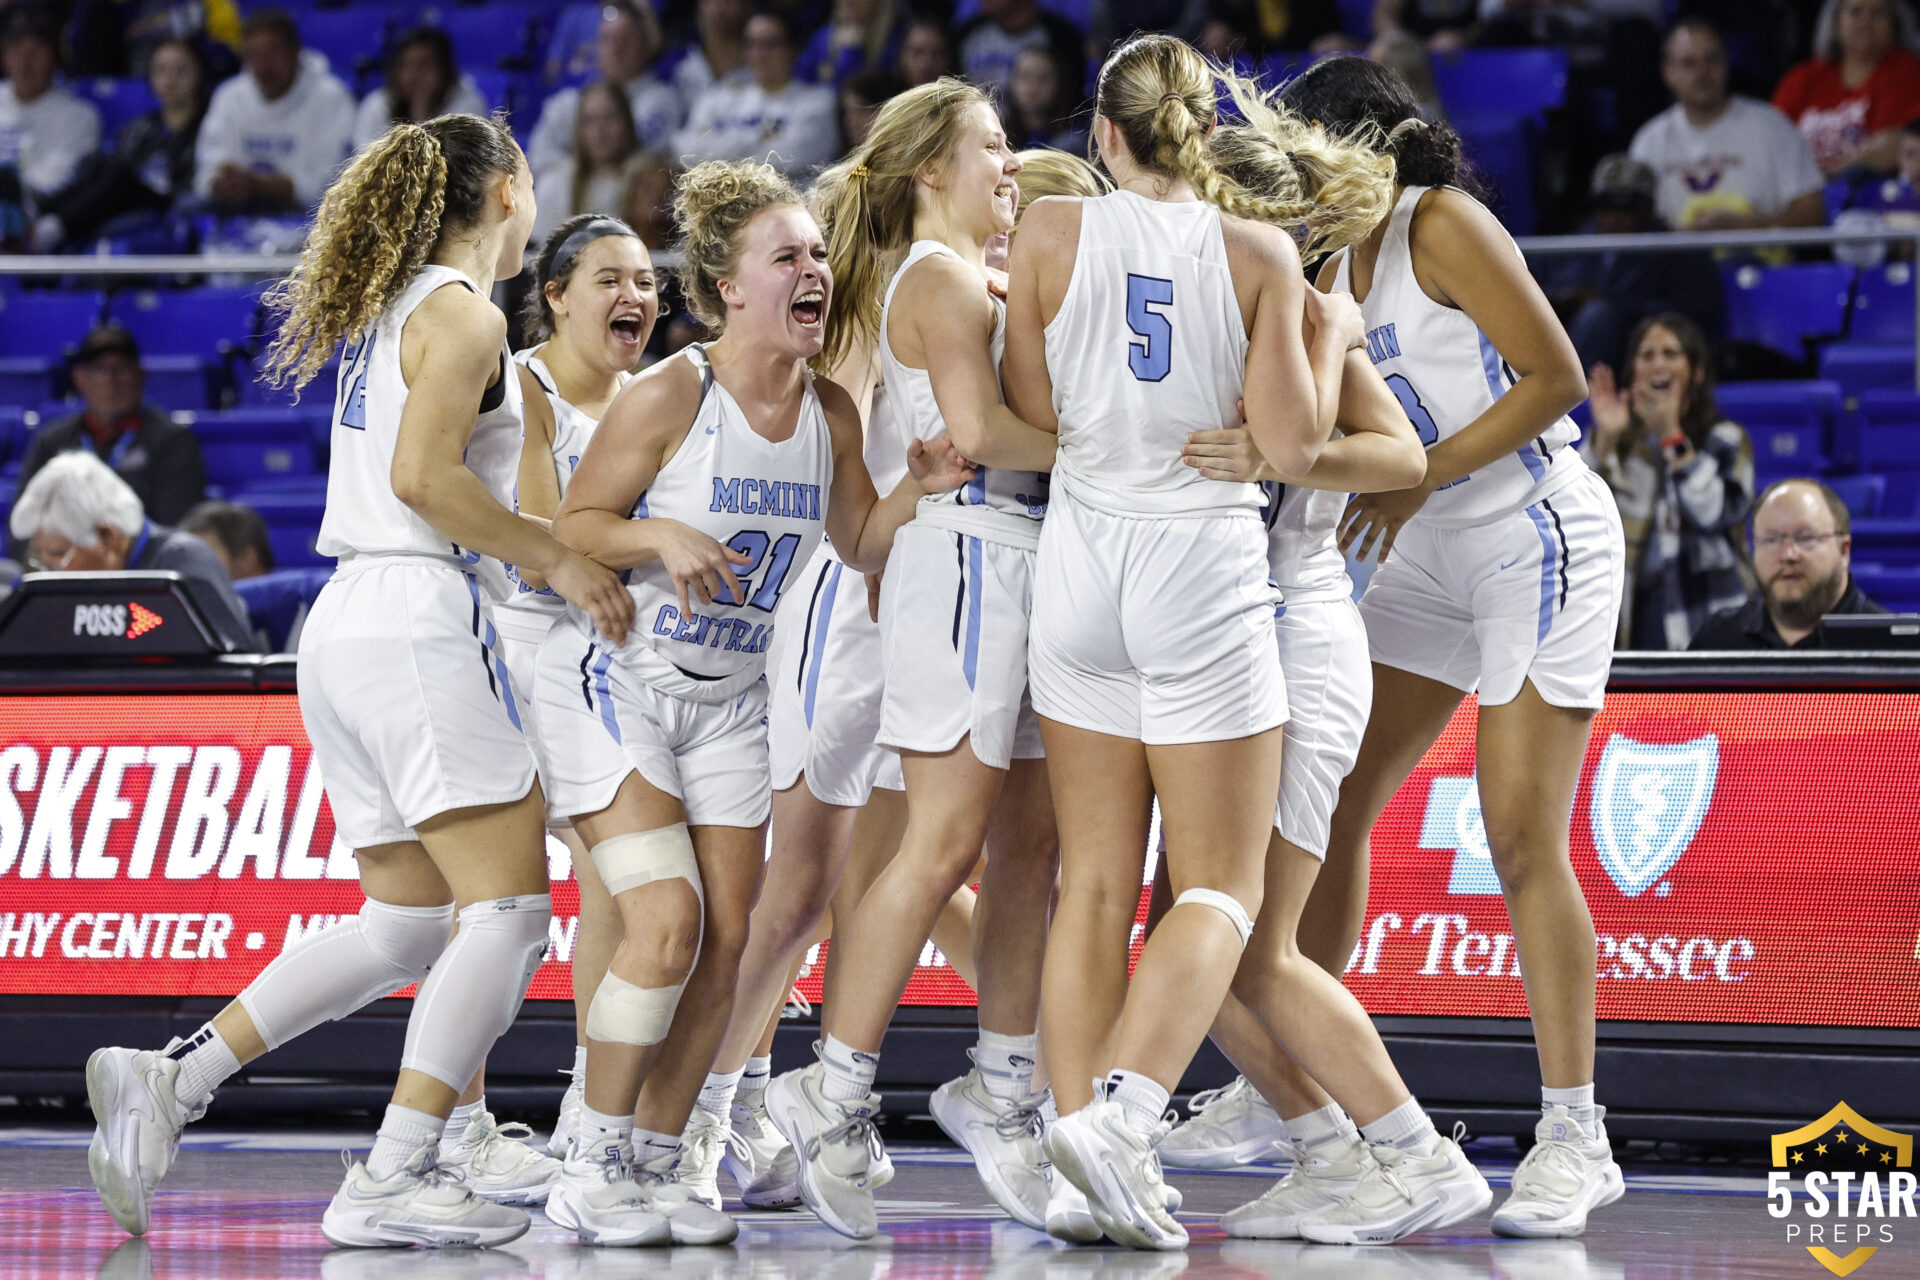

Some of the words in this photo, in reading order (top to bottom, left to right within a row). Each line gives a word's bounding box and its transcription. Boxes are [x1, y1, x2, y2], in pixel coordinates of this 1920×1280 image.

[1126, 272, 1173, 382] 5
[709, 477, 821, 520] MCMINN
[705, 530, 802, 613] 21
[73, 603, 127, 637] POSS
[61, 912, 235, 959] CENTER
[1411, 912, 1755, 982] Tenessee
